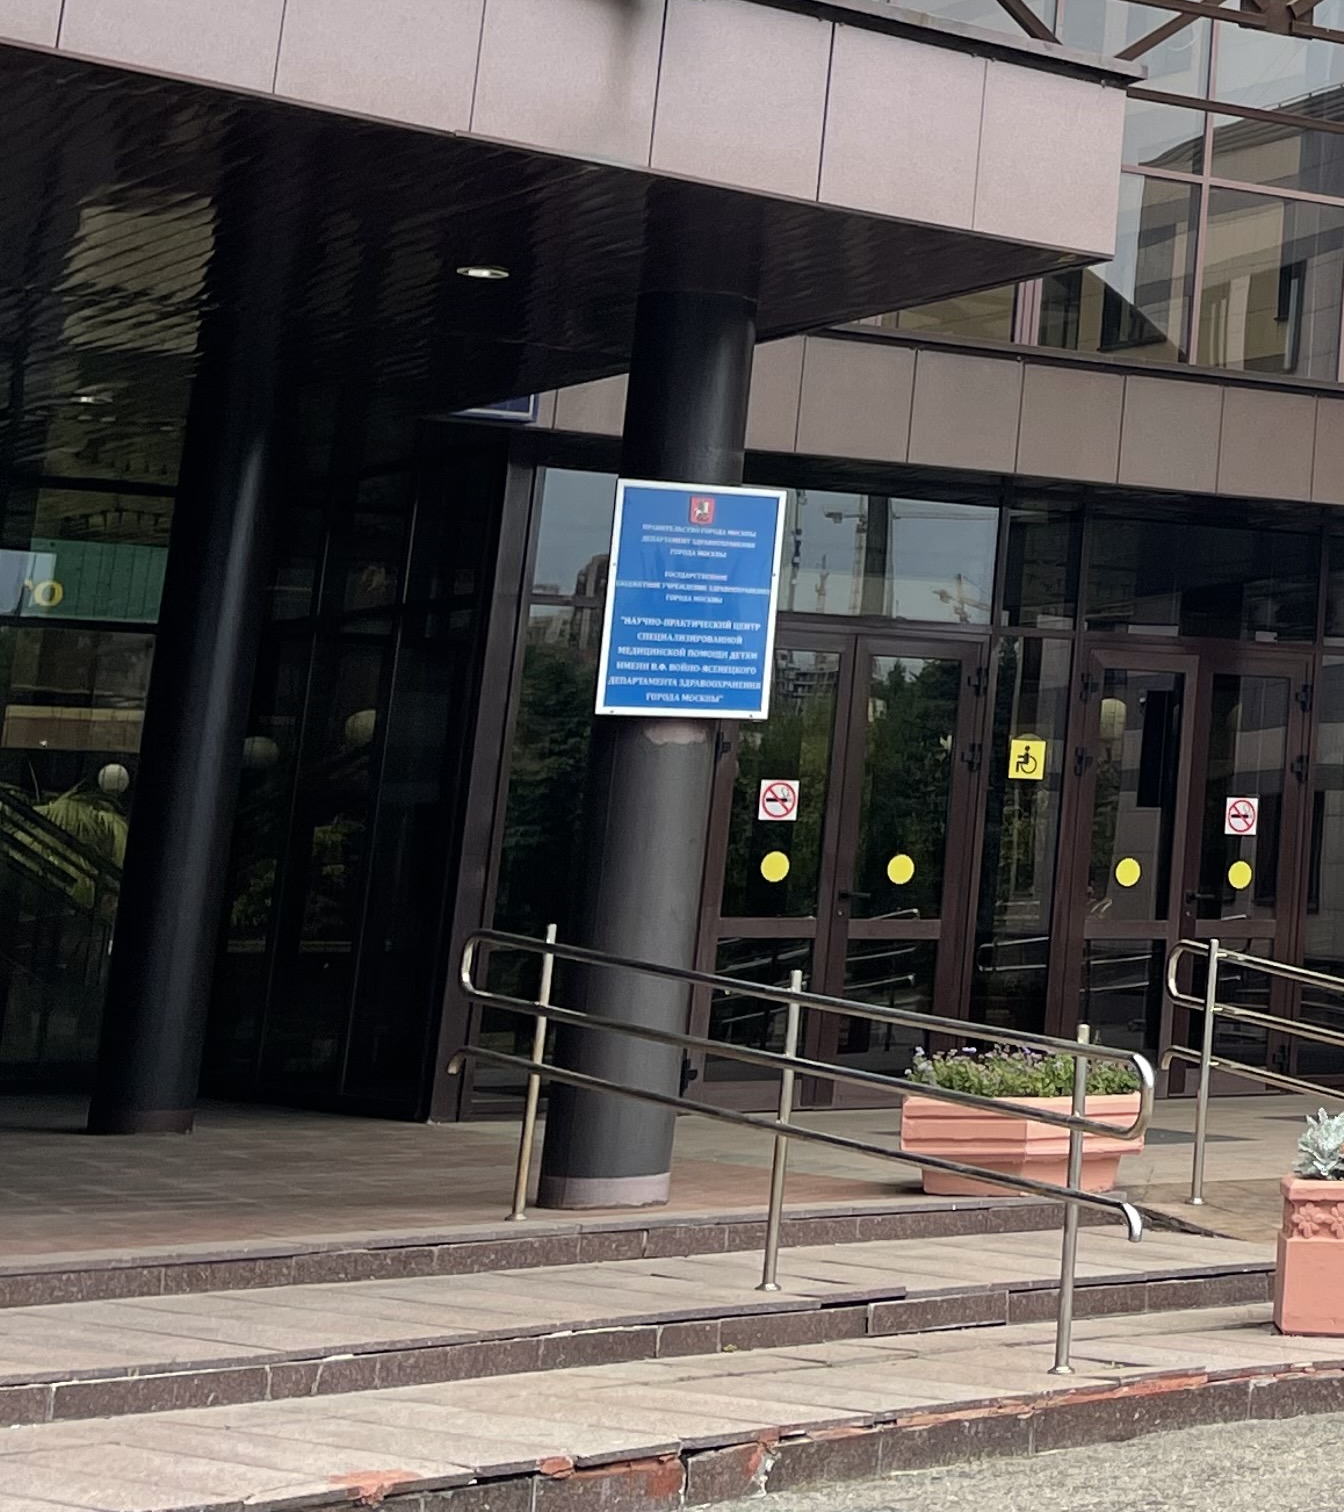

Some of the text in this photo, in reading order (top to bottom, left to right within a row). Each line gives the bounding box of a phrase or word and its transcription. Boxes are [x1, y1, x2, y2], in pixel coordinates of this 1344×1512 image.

[733, 622, 761, 631] ЦЕНТР
[618, 646, 685, 656] МЕДИЦИНСКОЙ
[688, 649, 727, 658] ПОМОЩИ
[616, 662, 649, 670] ИМЕНИ
[608, 676, 677, 687] ДЕПАРТАМЕНТА
[646, 693, 679, 701] ГОРОДА
